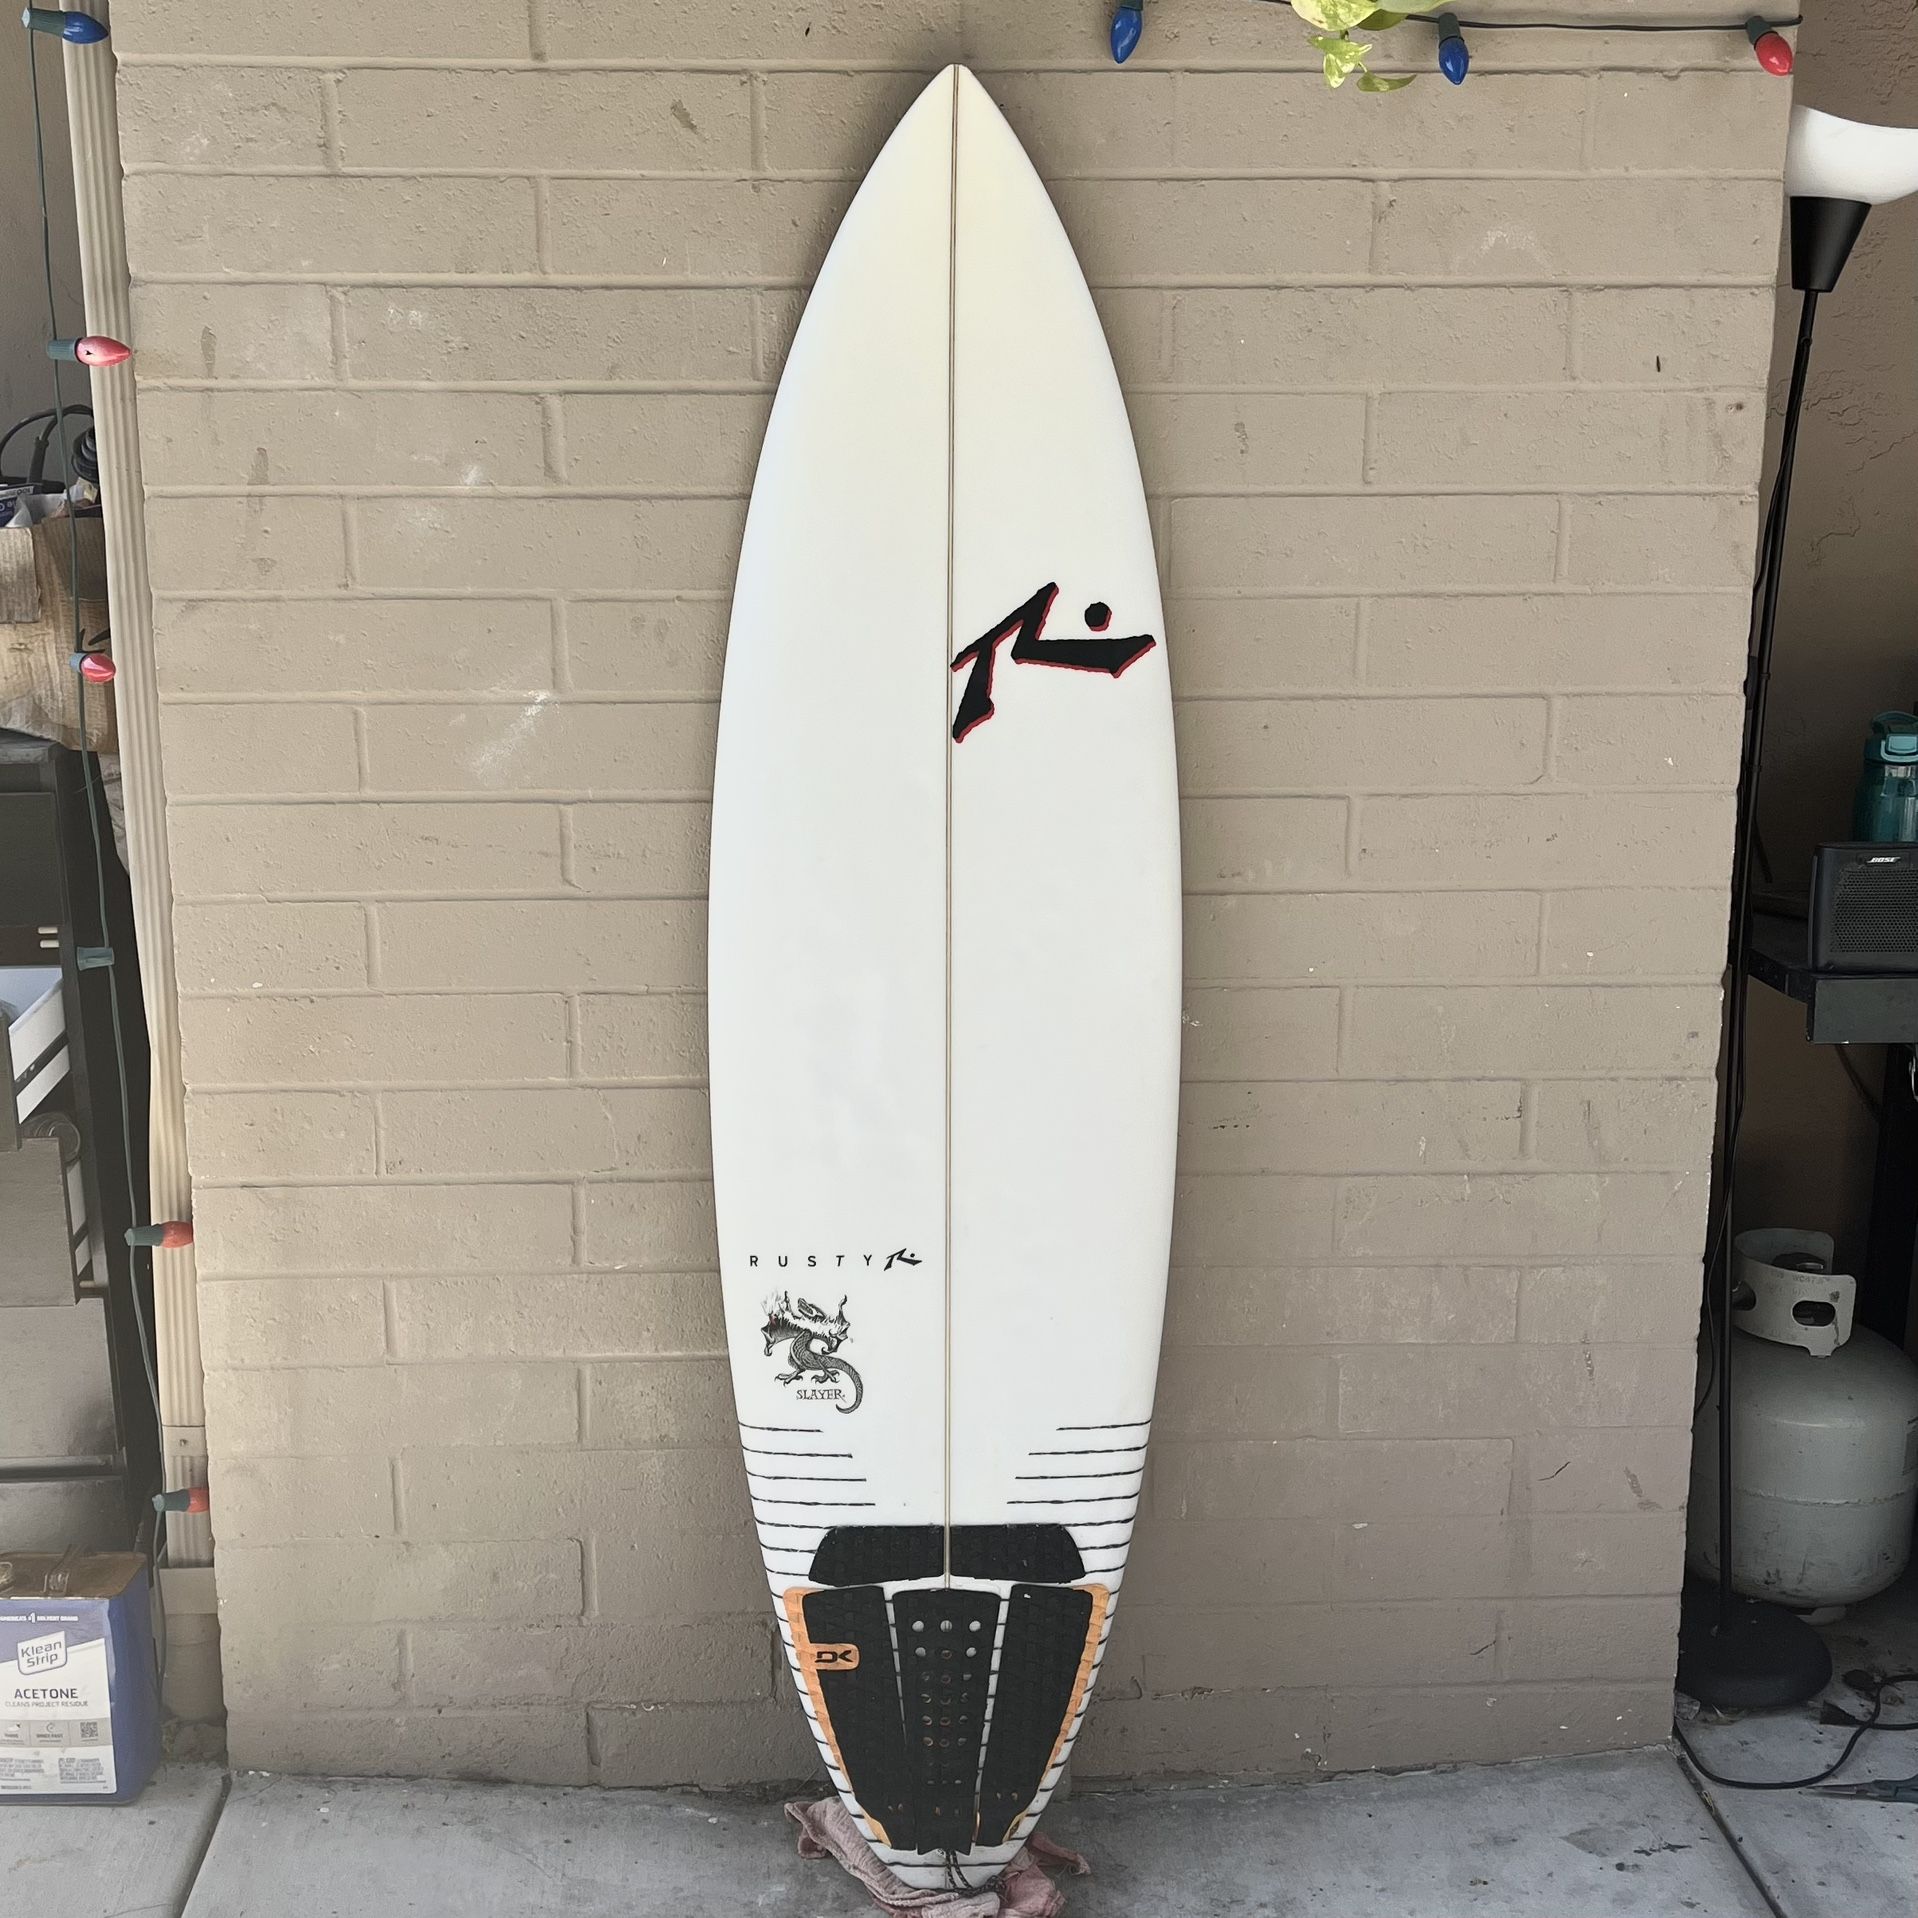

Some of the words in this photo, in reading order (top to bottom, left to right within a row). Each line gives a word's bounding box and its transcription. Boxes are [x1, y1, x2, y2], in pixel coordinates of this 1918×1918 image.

[749, 1254, 873, 1268] RUSTY
[21, 1641, 62, 1657] Klean
[815, 1649, 854, 1663] DK
[27, 1653, 59, 1668] Strip
[14, 1688, 79, 1699] ACETONE
